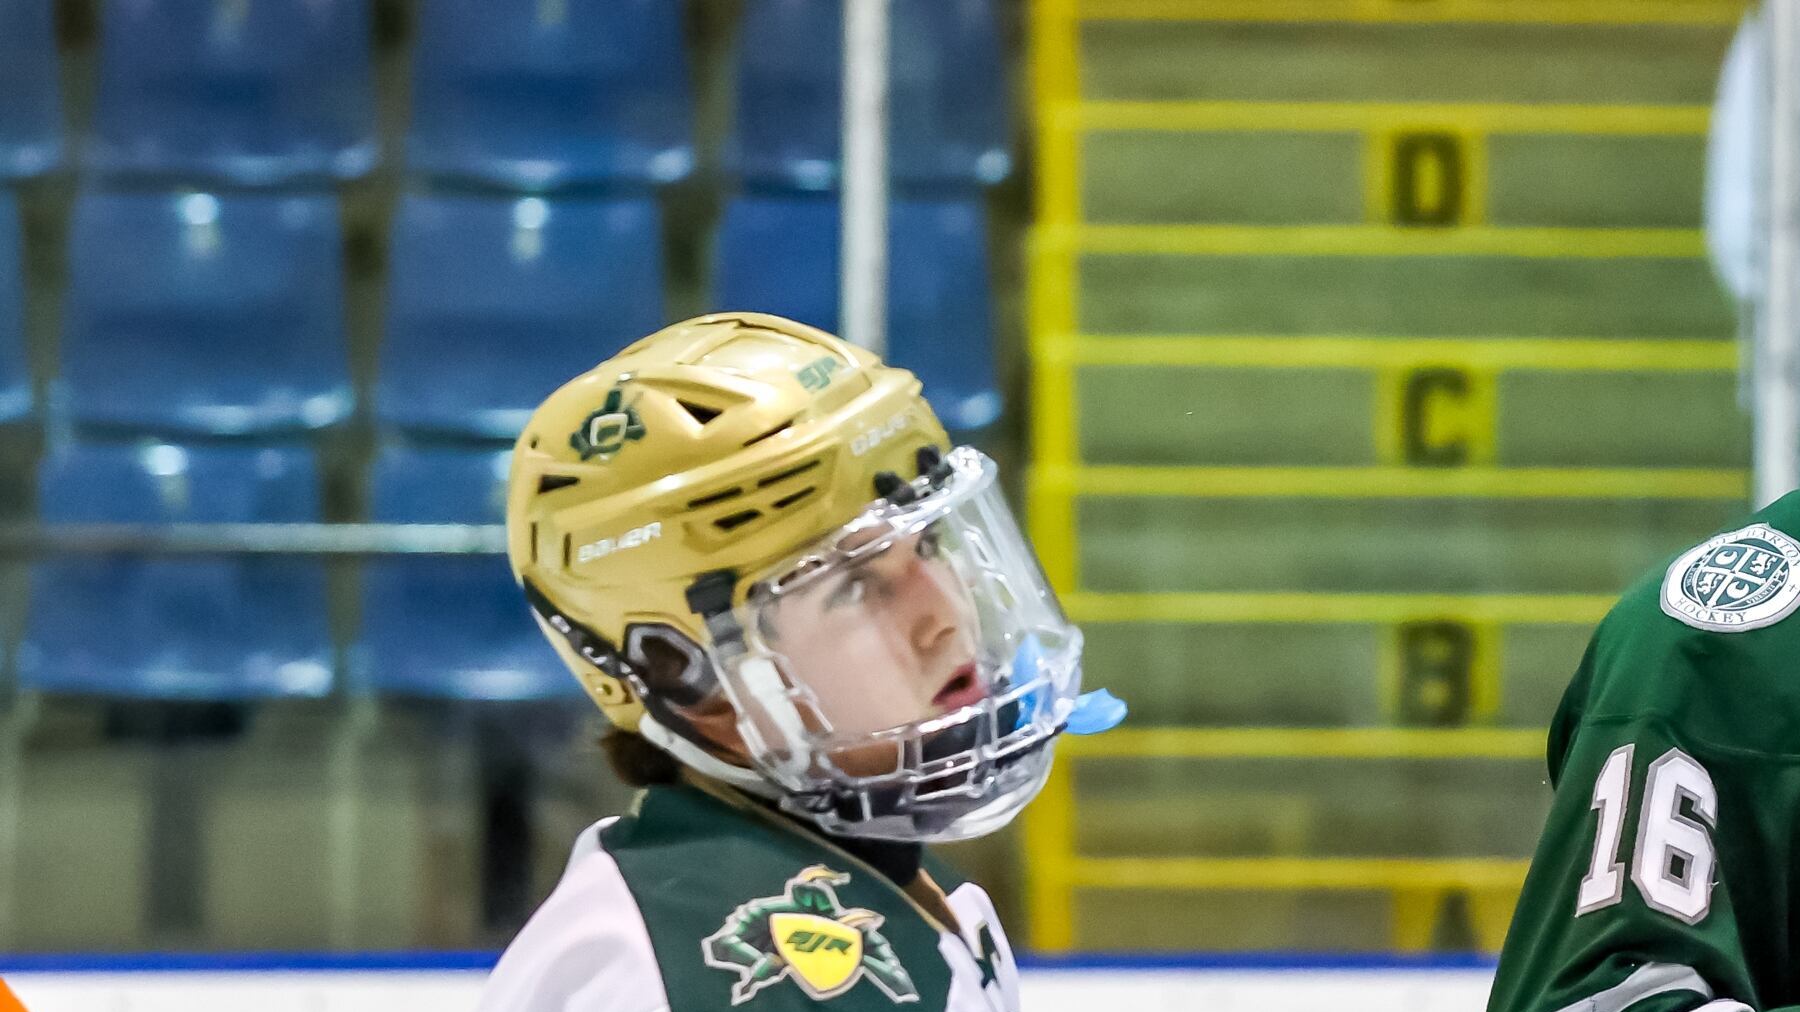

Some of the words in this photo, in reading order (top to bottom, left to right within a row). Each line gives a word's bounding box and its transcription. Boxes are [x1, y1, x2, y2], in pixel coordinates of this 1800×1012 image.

[1390, 132, 1466, 228] D
[1402, 367, 1471, 467] C
[1674, 597, 1747, 623] HOCKEY
[1401, 620, 1475, 728] B
[1575, 743, 1718, 926] 16
